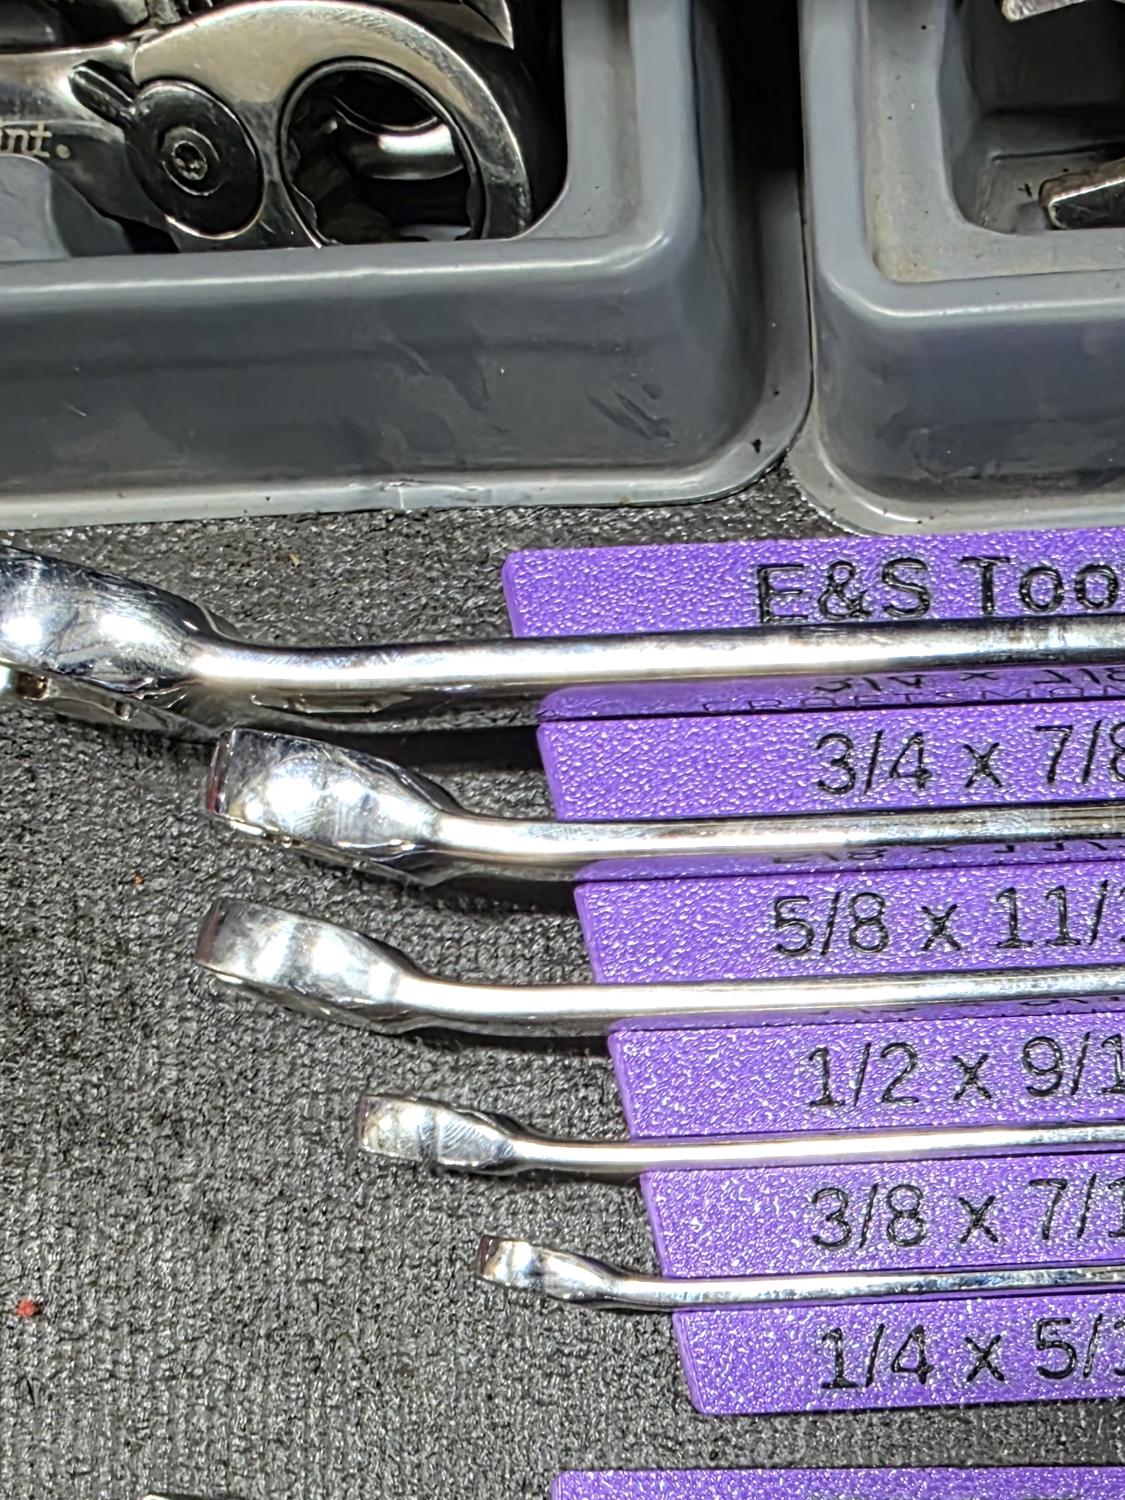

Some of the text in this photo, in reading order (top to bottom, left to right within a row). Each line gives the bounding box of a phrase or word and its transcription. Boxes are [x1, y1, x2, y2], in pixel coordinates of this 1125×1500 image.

[755, 556, 931, 624] E&S
[816, 730, 931, 795] 3/4
[964, 742, 1003, 788] x
[773, 891, 890, 956] 5/8
[921, 904, 961, 950] x
[808, 1042, 919, 1107] 1/2
[952, 1053, 992, 1101] x
[811, 1183, 926, 1248] 3/8
[958, 1196, 998, 1244] x
[821, 1323, 934, 1388] 1/4
[965, 1334, 1005, 1382] x
